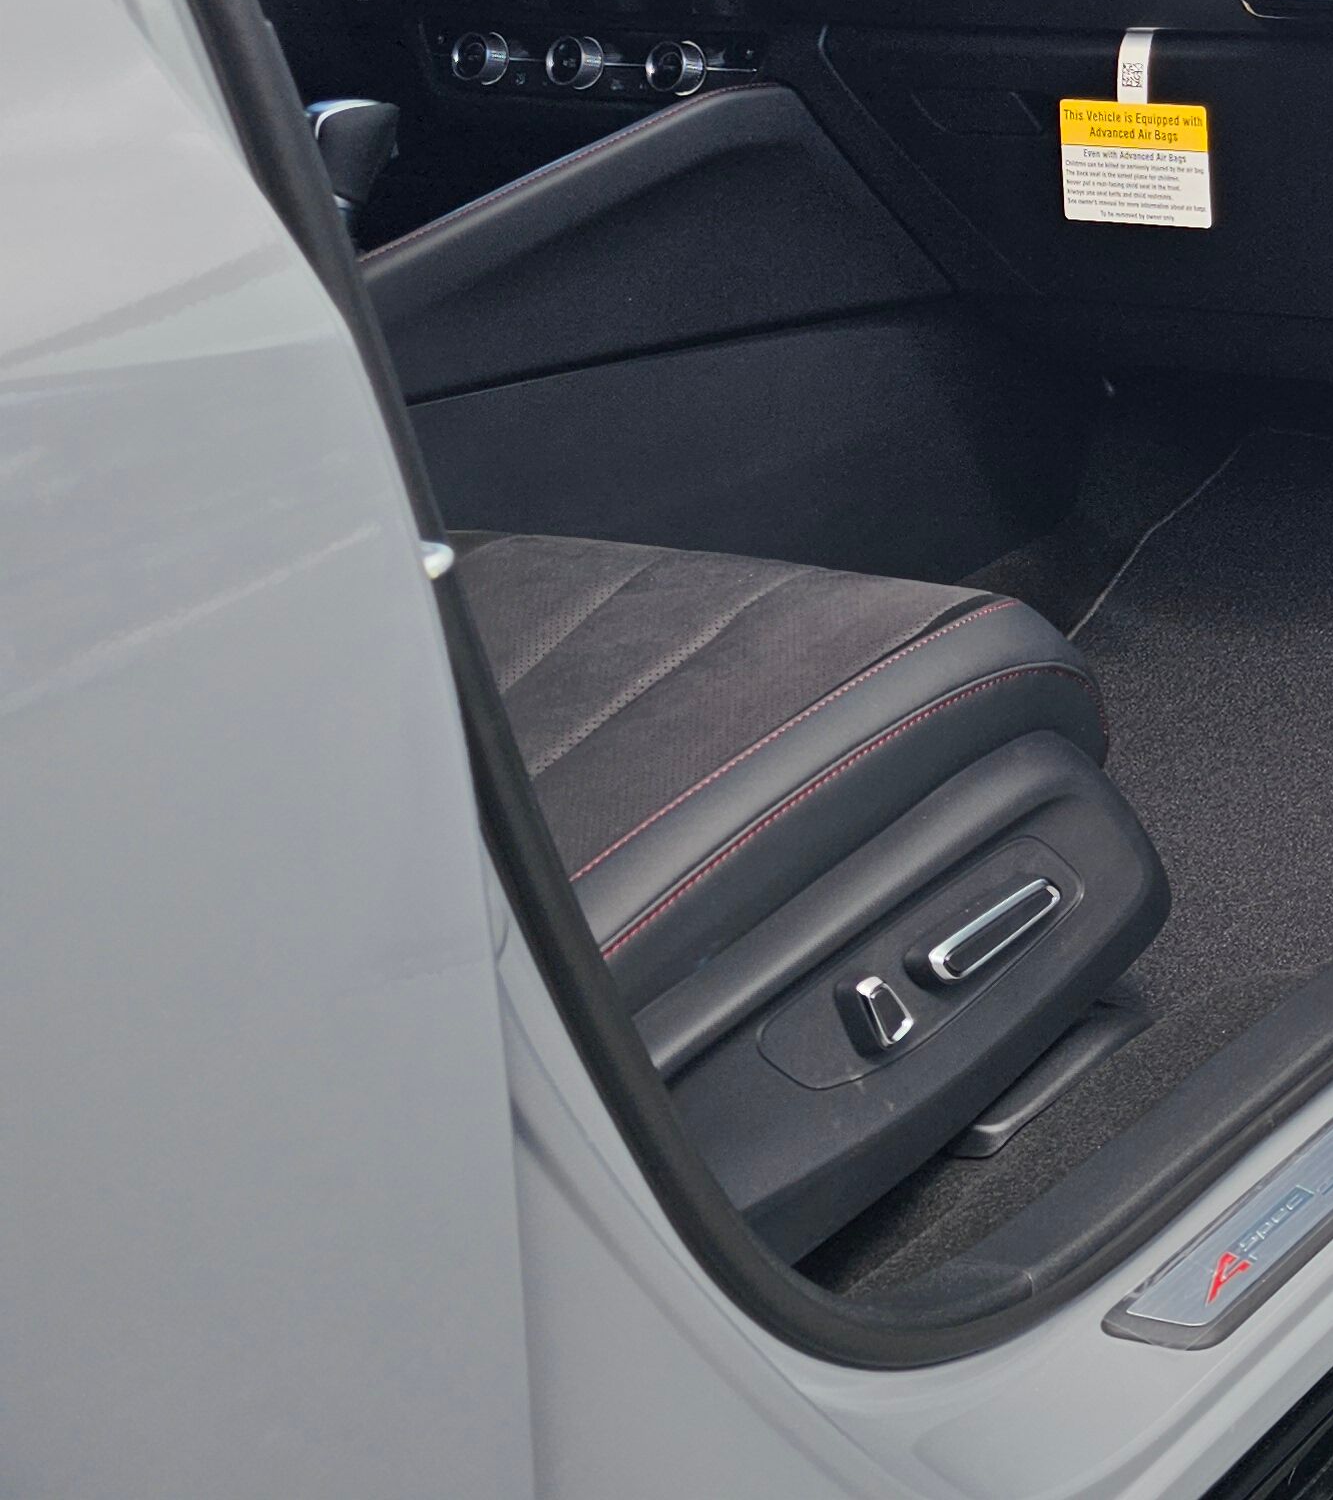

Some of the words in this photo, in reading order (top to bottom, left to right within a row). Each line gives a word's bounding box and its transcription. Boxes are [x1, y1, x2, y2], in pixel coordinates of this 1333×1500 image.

[1064, 109, 1083, 121] This
[1087, 111, 1121, 123] Vehicle
[1125, 112, 1133, 124] is
[1136, 113, 1180, 127] Equipped
[1183, 116, 1203, 127] with
[1090, 127, 1135, 139] Advanced
[1138, 129, 1152, 140] Air
[1155, 130, 1178, 143] Bags
[1083, 149, 1100, 158] Even
[1103, 149, 1117, 159] with
[1120, 150, 1154, 161] Advanced
[1156, 152, 1167, 161] Air
[1169, 153, 1187, 164] Bags
